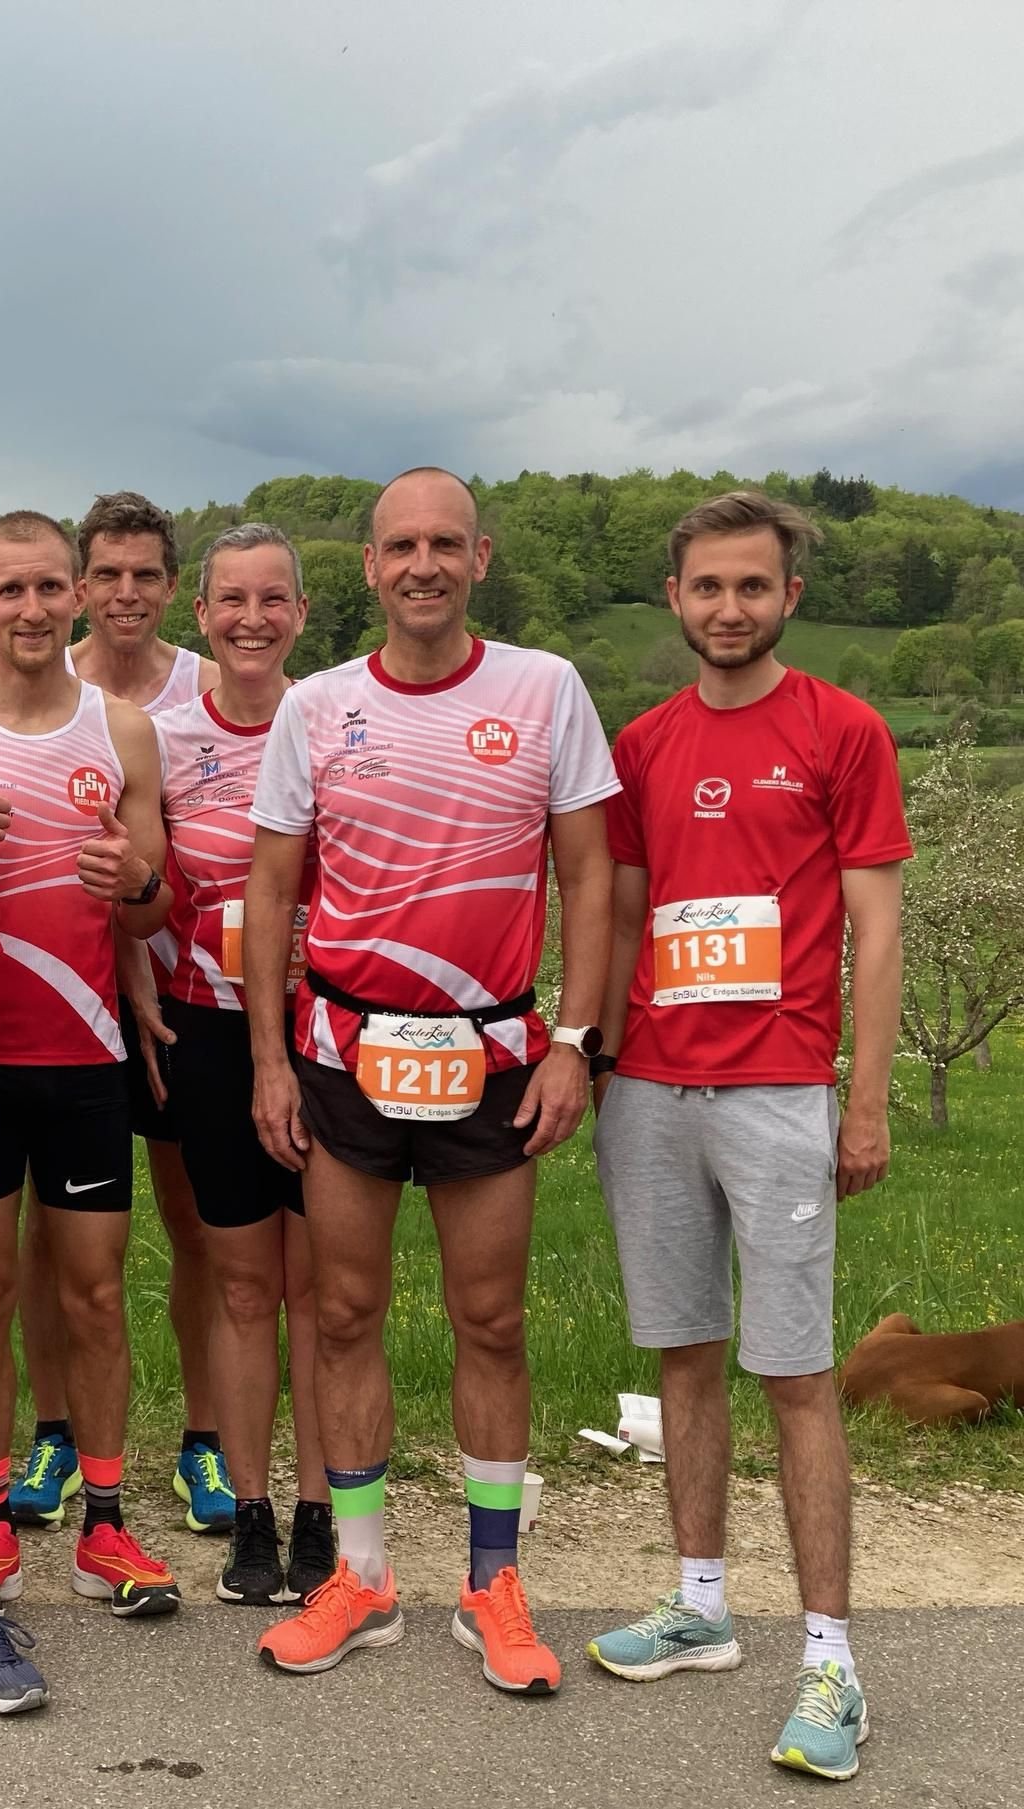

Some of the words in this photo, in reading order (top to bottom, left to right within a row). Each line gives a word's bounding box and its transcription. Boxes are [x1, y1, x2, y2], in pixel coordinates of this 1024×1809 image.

[342, 719, 367, 730] erima
[668, 933, 746, 970] 1131
[696, 972, 715, 982] Nils
[672, 990, 698, 1000] EnBW
[713, 988, 738, 997] Erdgas
[741, 987, 772, 995] Südwest
[376, 1056, 469, 1096] 1212
[383, 1104, 413, 1116] EnBW
[428, 1108, 452, 1117] Erdgas
[797, 1203, 821, 1217] NIKE
